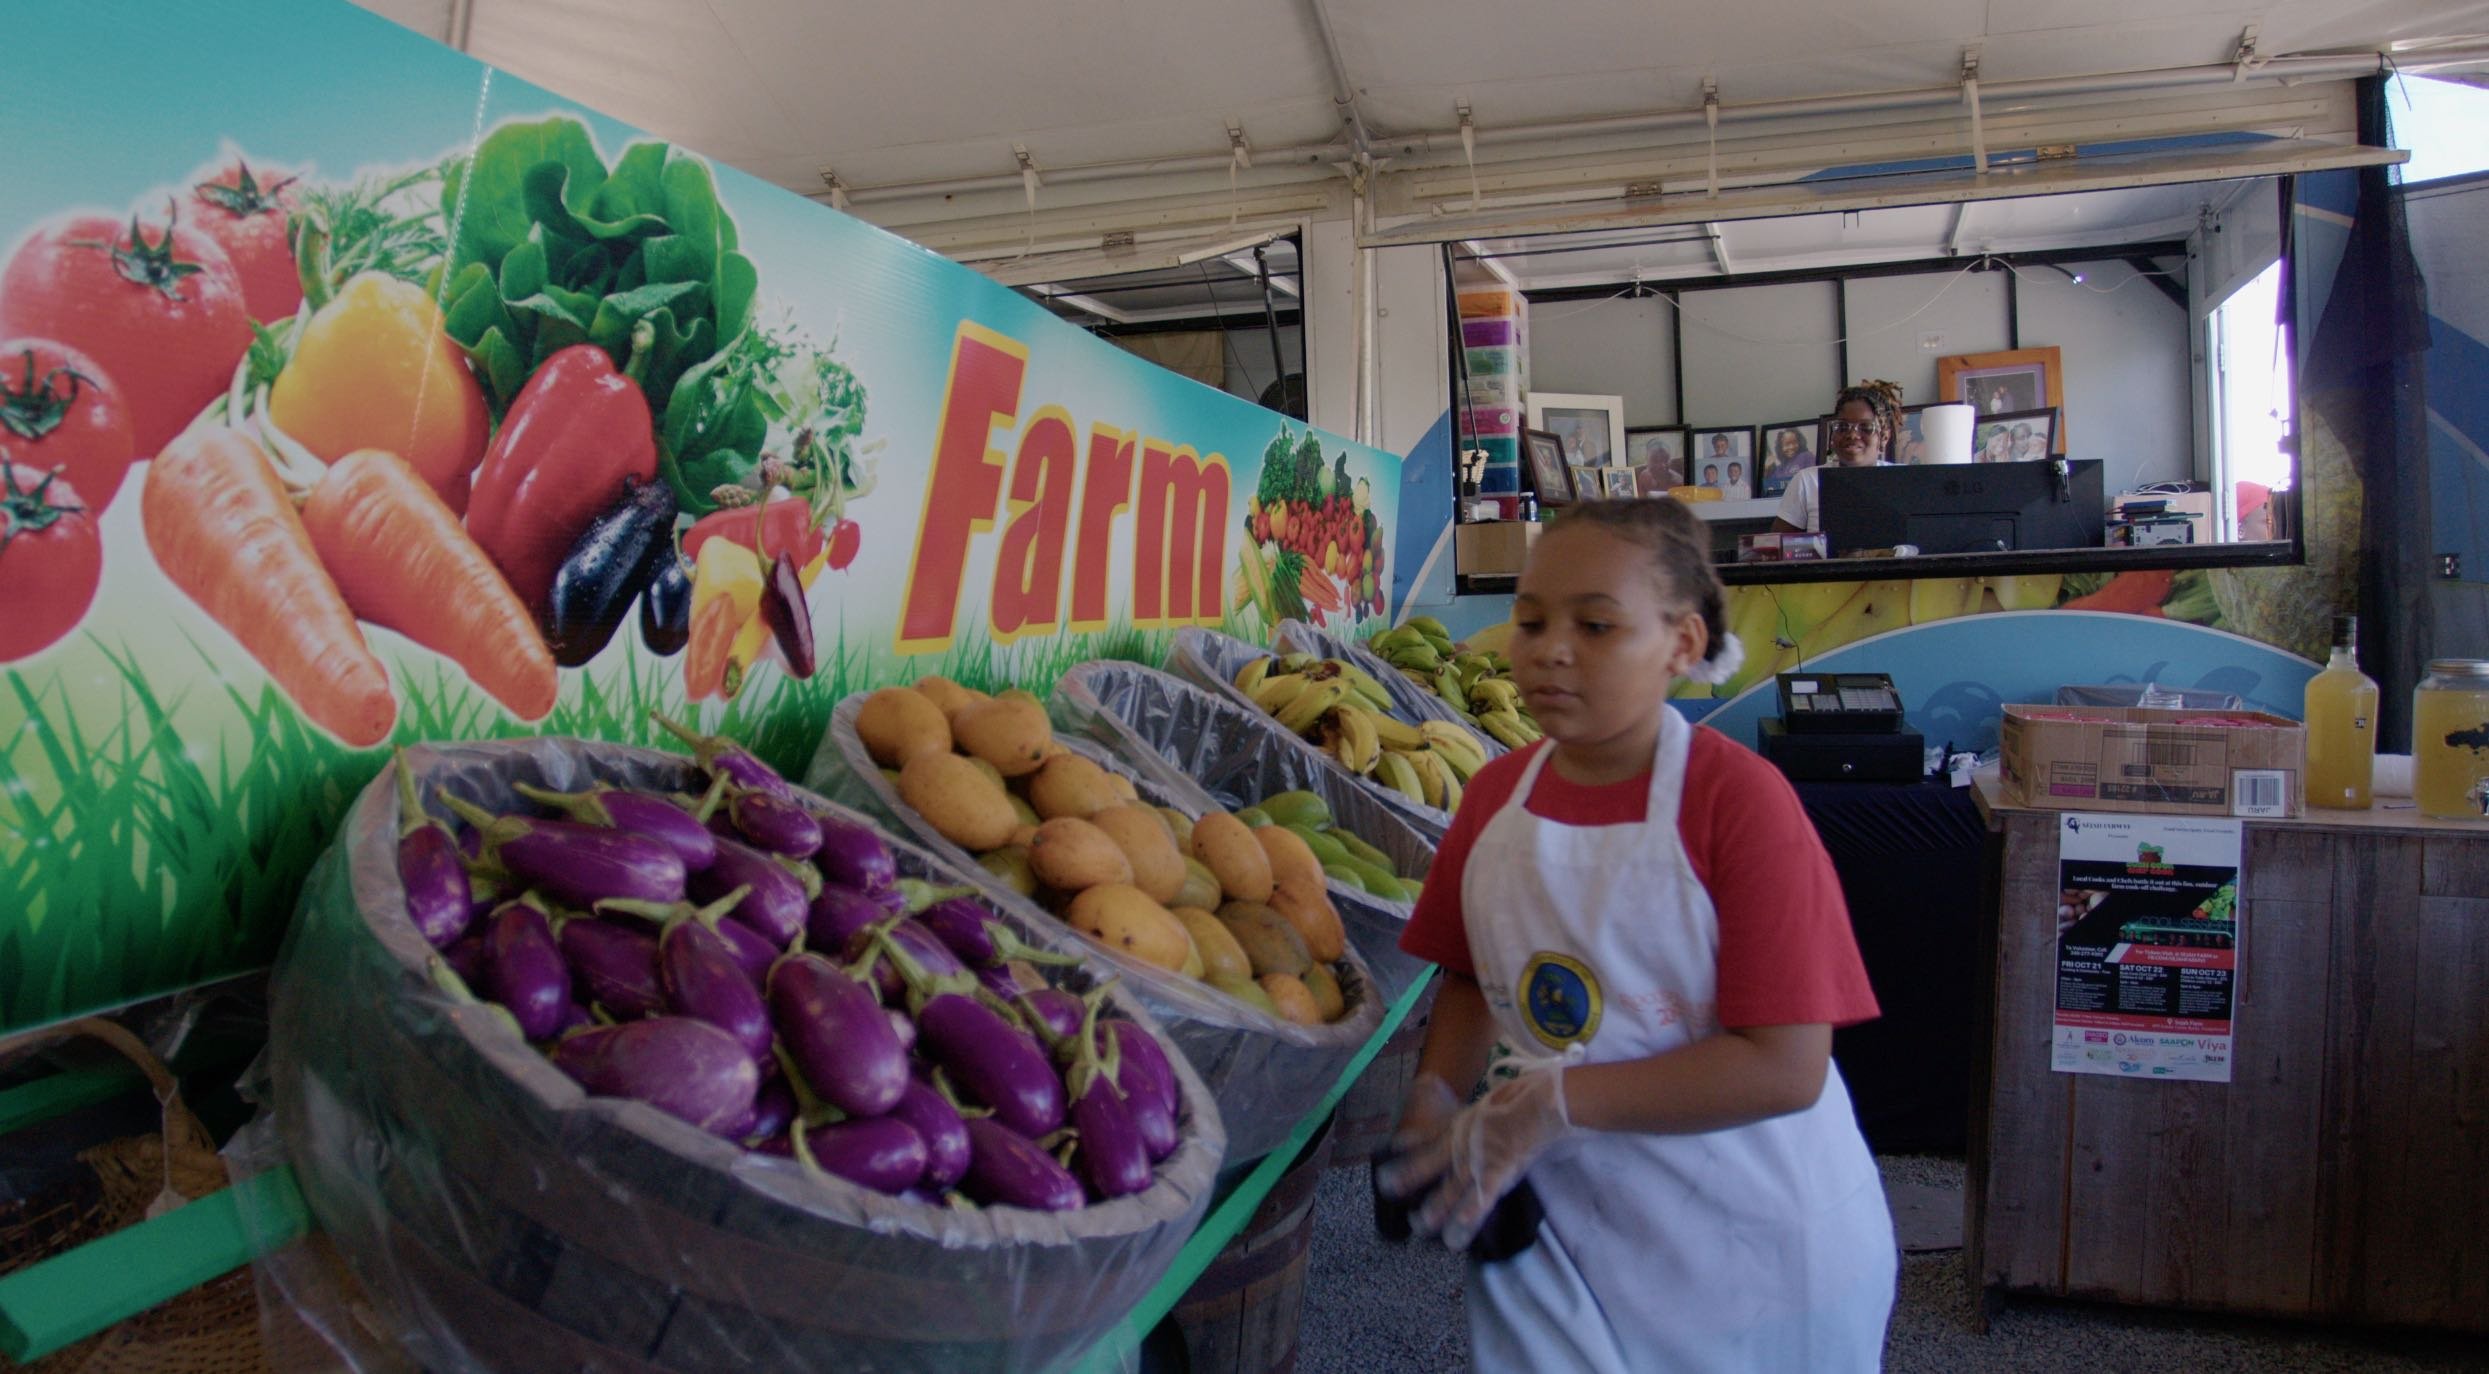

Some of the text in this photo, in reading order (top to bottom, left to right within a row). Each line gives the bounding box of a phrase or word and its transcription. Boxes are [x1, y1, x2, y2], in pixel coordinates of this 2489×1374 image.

[893, 319, 1231, 655] Farm
[2247, 807, 2271, 815] JARU
[2061, 960, 2102, 970] FRI OCT 21
[2198, 1038, 2227, 1052] Viya
